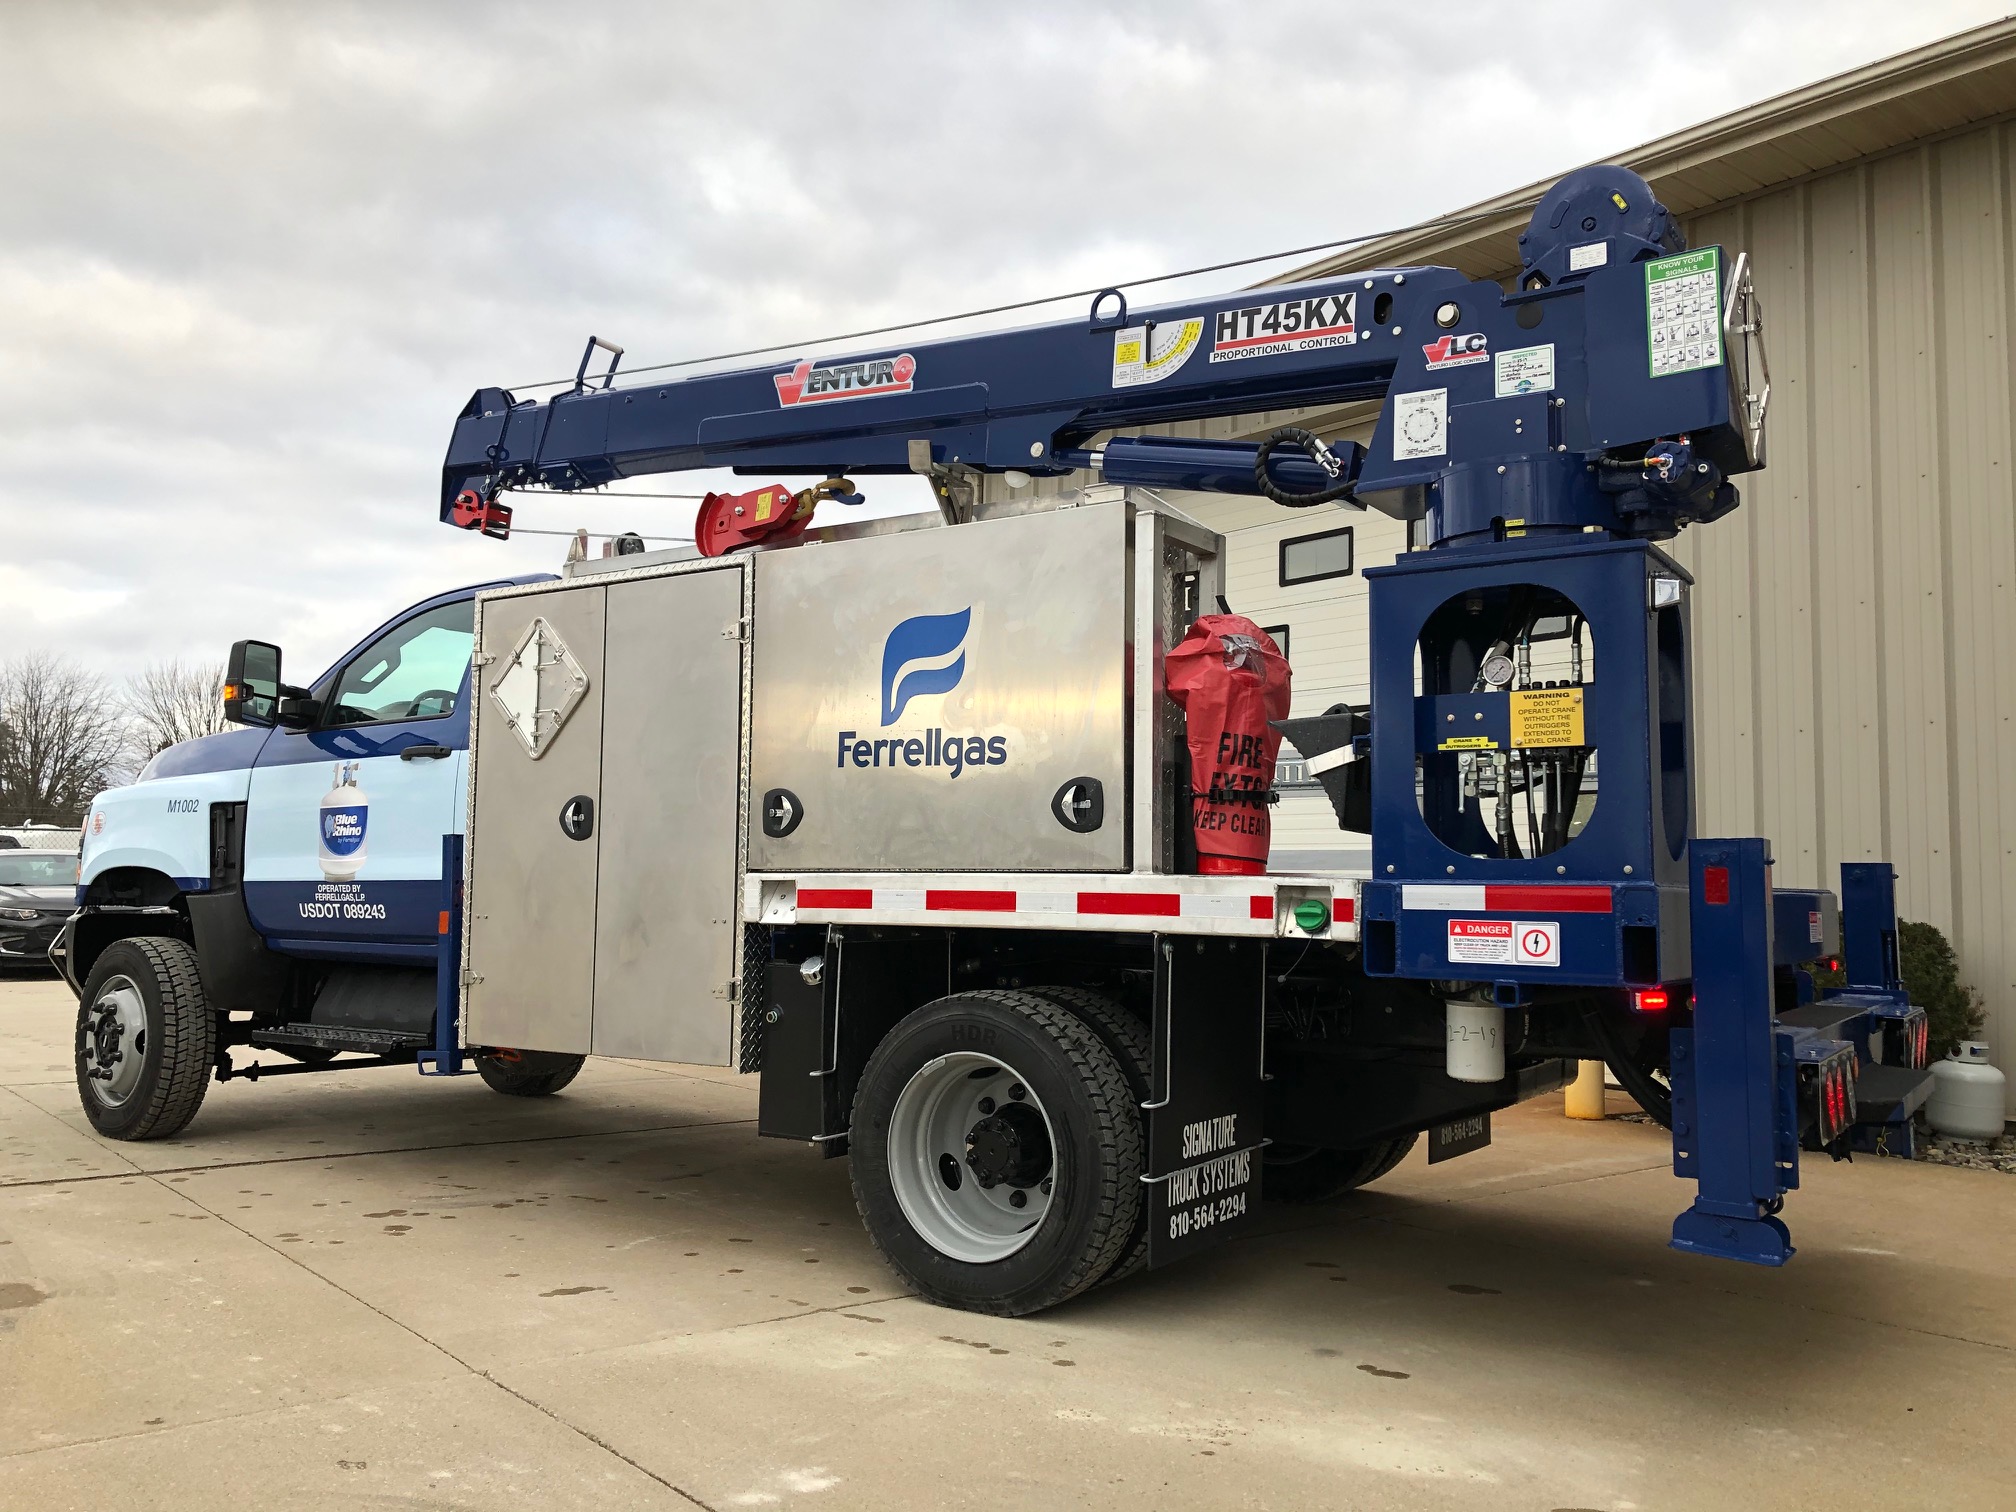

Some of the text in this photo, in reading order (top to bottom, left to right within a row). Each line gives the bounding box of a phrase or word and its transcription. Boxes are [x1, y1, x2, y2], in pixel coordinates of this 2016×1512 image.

[1658, 255, 1704, 270] KNOW YOUR
[1665, 265, 1698, 277] SIGNALS
[1217, 294, 1354, 342] HT45KX
[1213, 335, 1352, 361] PROPORTIONAL CONTROL
[1512, 351, 1537, 359] INSPECTED
[1427, 362, 1449, 370] VENTURO
[1463, 356, 1489, 364] CONTROLS
[776, 355, 914, 405] VENTURO
[1523, 692, 1570, 700] WARNING
[837, 728, 1008, 780] Ferrellgas
[1216, 731, 1263, 769] FIRE
[167, 799, 199, 813] M1002
[335, 814, 358, 825] Blue
[1194, 809, 1227, 830] KEEP
[332, 825, 362, 837] Rhino
[318, 884, 361, 893] OPERATED BY
[299, 903, 386, 919] USDOT 089243
[1466, 925, 1509, 934] DANGER
[1182, 1114, 1237, 1159] SIGNATURE
[1168, 1151, 1250, 1207] TRUCK SYSTEMS
[1169, 1192, 1246, 1239] 810-564-2294
